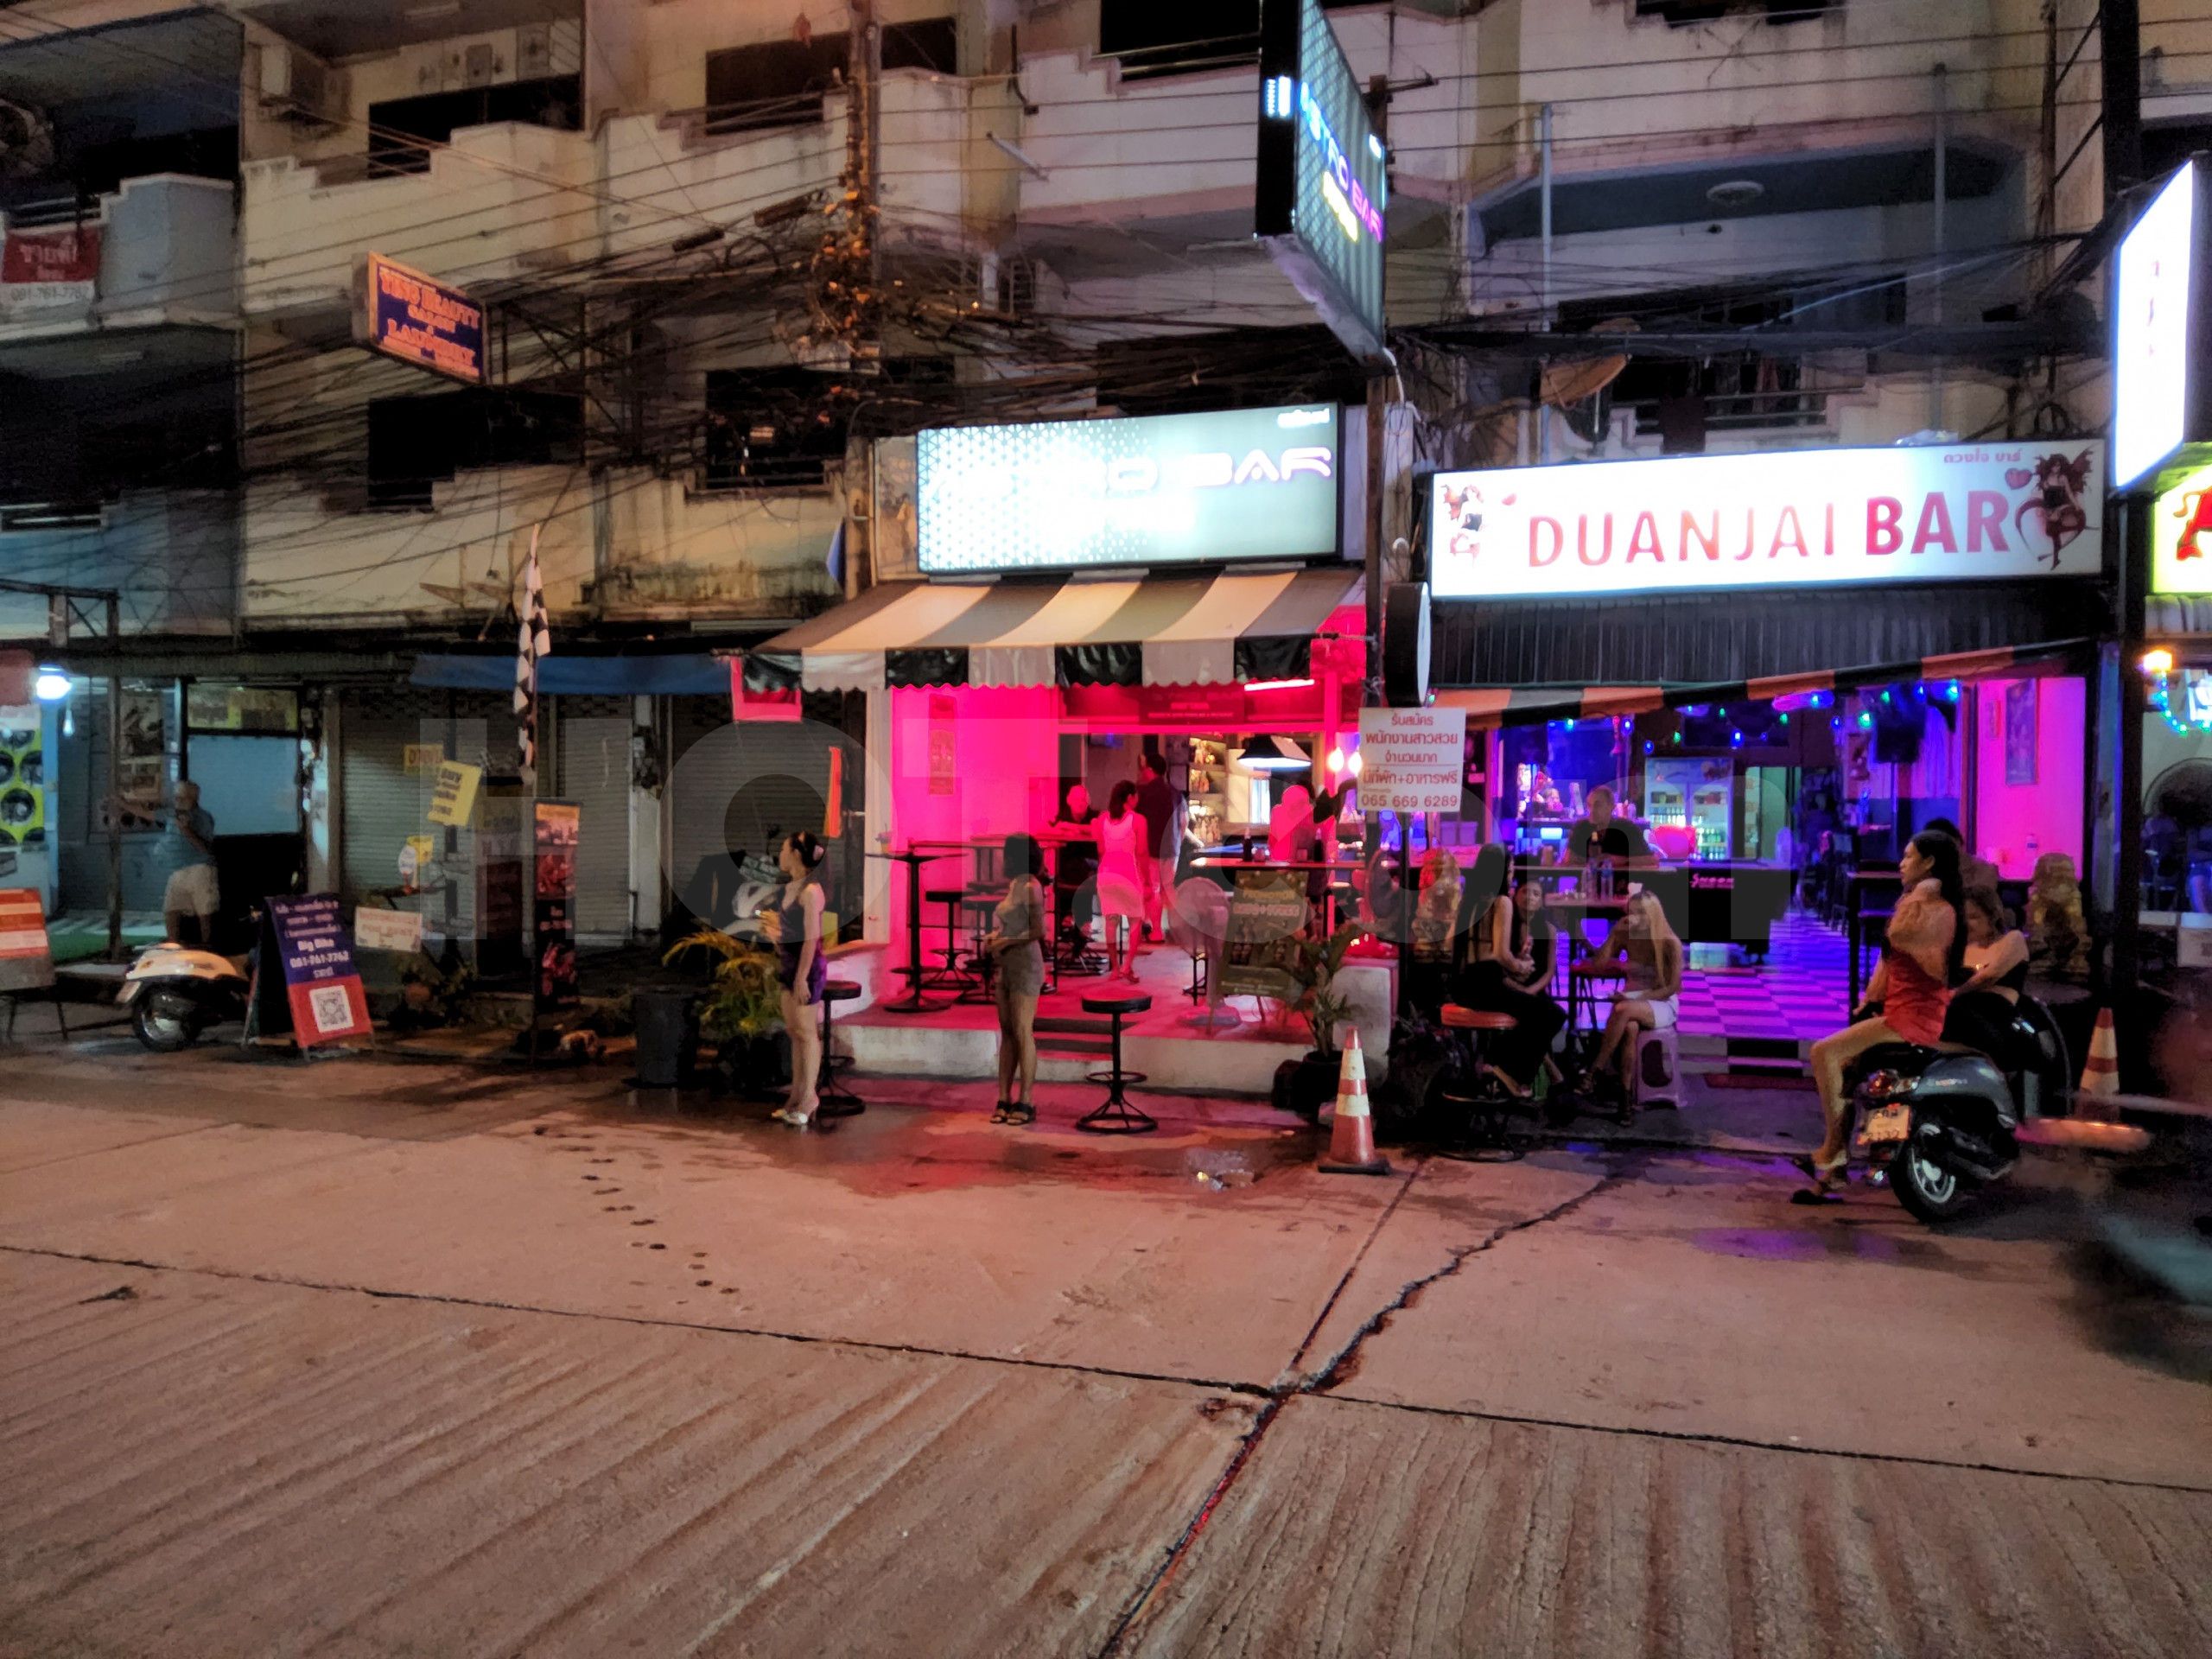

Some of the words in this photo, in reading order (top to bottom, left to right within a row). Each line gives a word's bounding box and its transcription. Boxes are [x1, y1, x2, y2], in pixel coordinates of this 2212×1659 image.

[1527, 502, 1836, 569] DUANJAI
[1866, 490, 2010, 556] BAR
[1362, 795, 1387, 807] 065
[1392, 795, 1418, 808] 669
[1424, 795, 1458, 808] 6289
